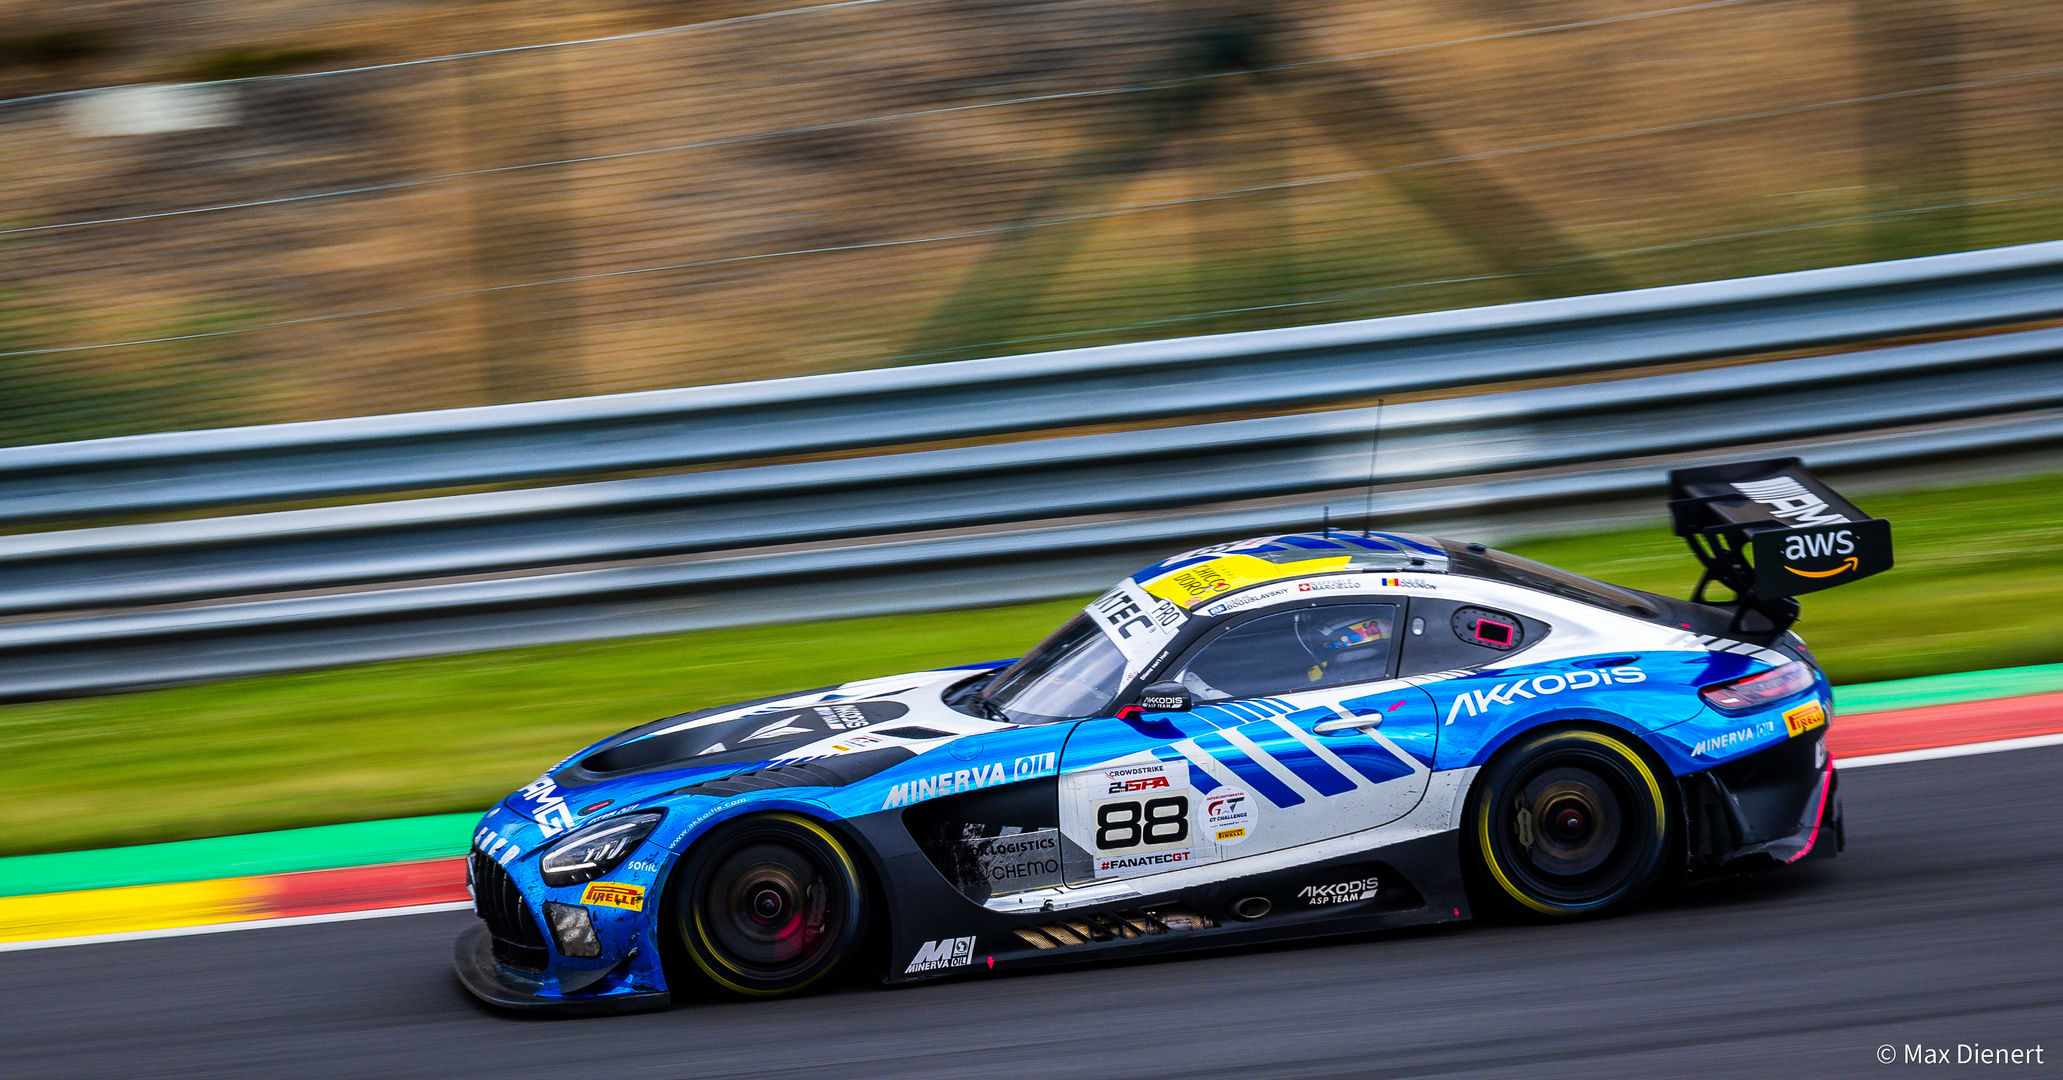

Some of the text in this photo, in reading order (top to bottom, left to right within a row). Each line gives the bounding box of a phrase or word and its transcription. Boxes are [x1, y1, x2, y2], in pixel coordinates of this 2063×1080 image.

[1785, 529, 1855, 561] aws
[1152, 601, 1181, 627] PRO
[1691, 727, 1754, 757] MINERVA
[881, 752, 1056, 811] MINERVA OIL
[1109, 765, 1165, 778] CROWDSTRIKE
[668, 797, 747, 849] www.akkodis.com
[1096, 796, 1189, 850] 88
[1217, 812, 1248, 821] CHALLENGE
[990, 838, 1055, 855] LOGISTICS
[1101, 852, 1191, 871] #FANATECGT
[586, 885, 638, 906] PIRELLI
[1309, 893, 1358, 905] ASP TEAM
[904, 956, 967, 974] MINERVA OIL
